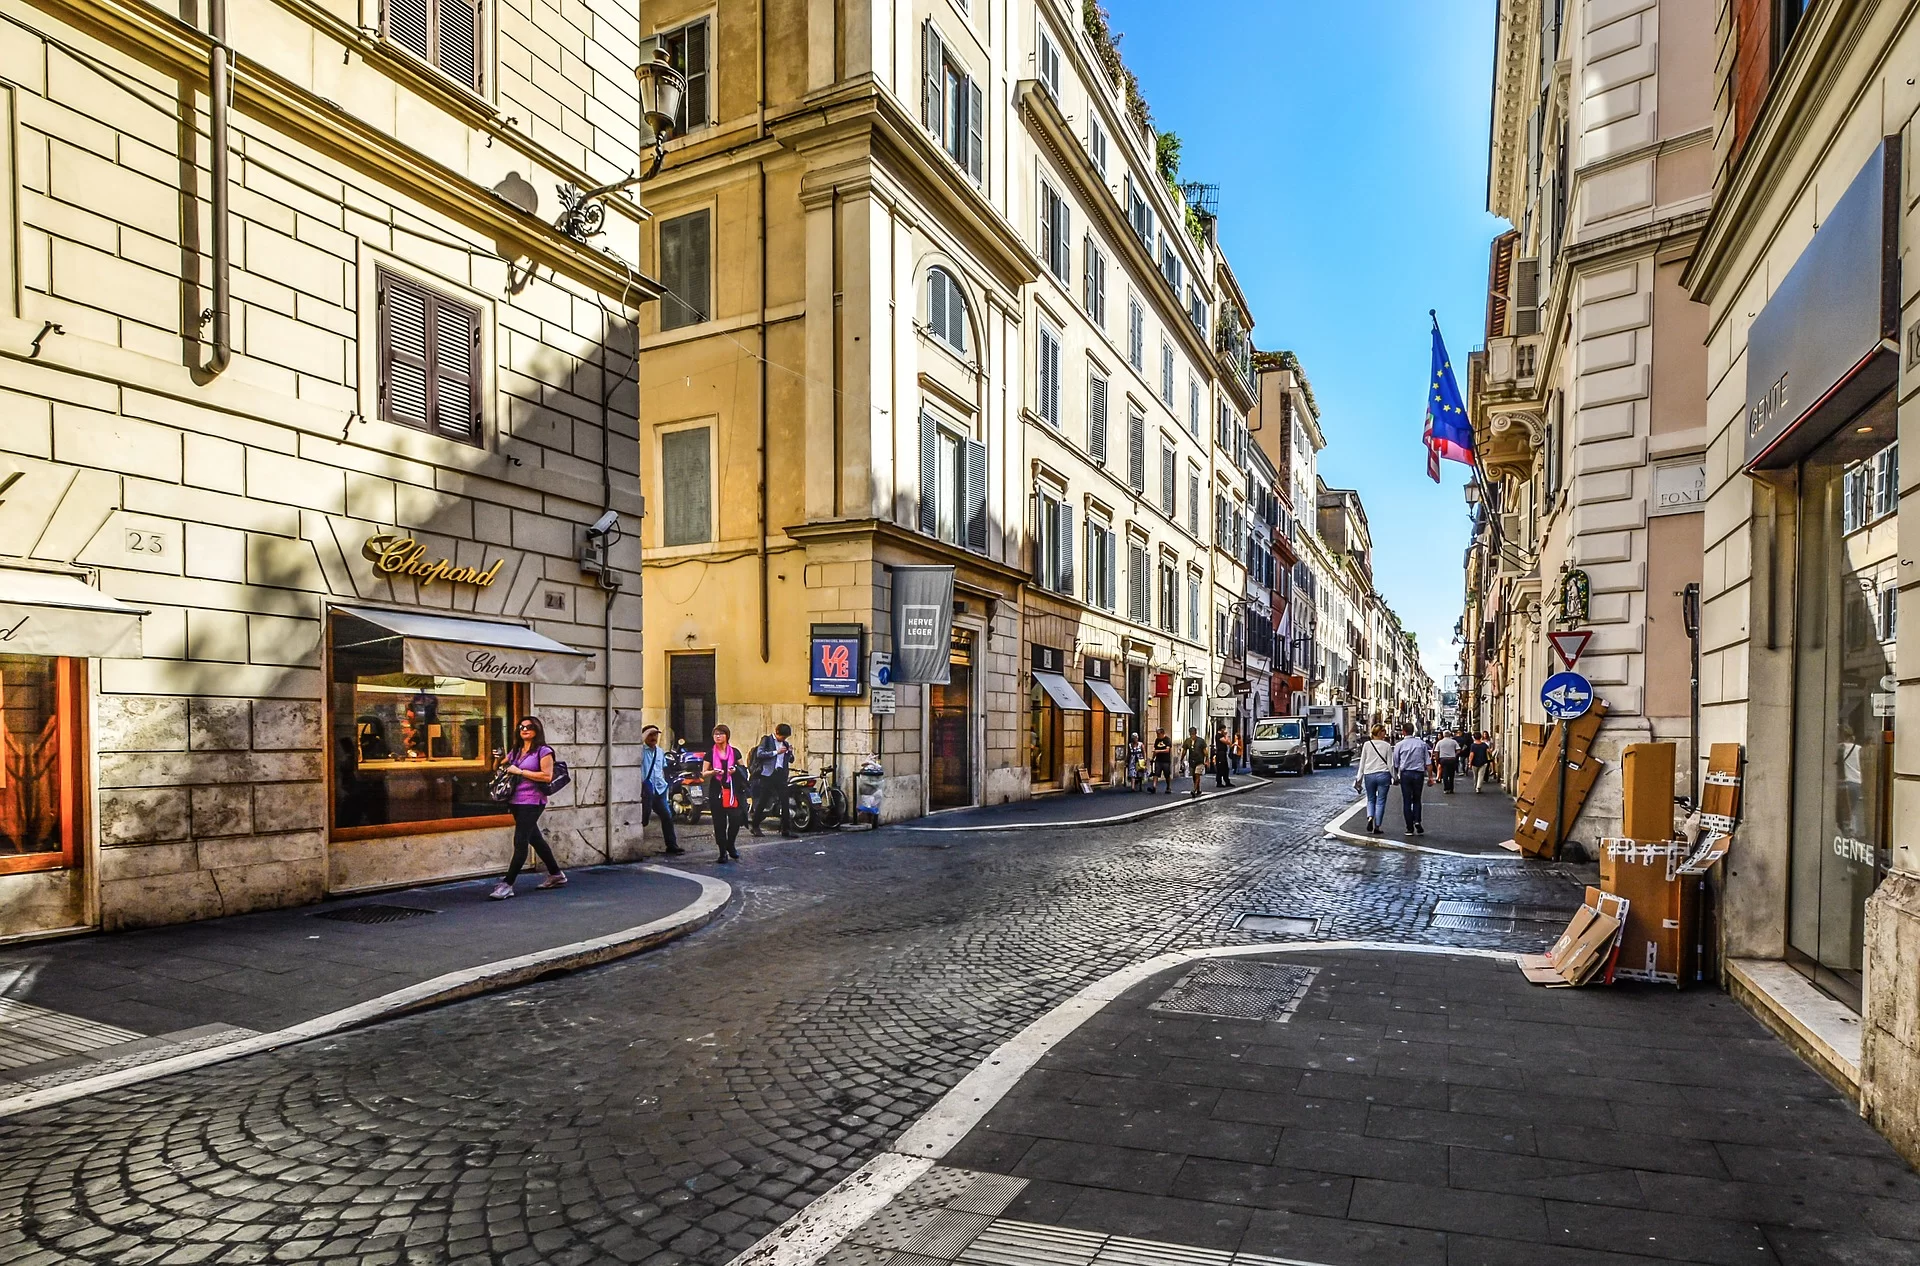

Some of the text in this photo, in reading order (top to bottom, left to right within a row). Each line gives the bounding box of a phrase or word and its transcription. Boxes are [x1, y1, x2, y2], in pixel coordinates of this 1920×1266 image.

[1749, 371, 1788, 438] GENTE
[1661, 489, 1705, 504] FONT
[129, 532, 163, 554] 23
[367, 533, 504, 586] Chopard
[907, 628, 933, 636] LEGER
[908, 618, 933, 626] HERVE
[466, 650, 538, 678] Chopard
[1833, 835, 1874, 867] GENTE
